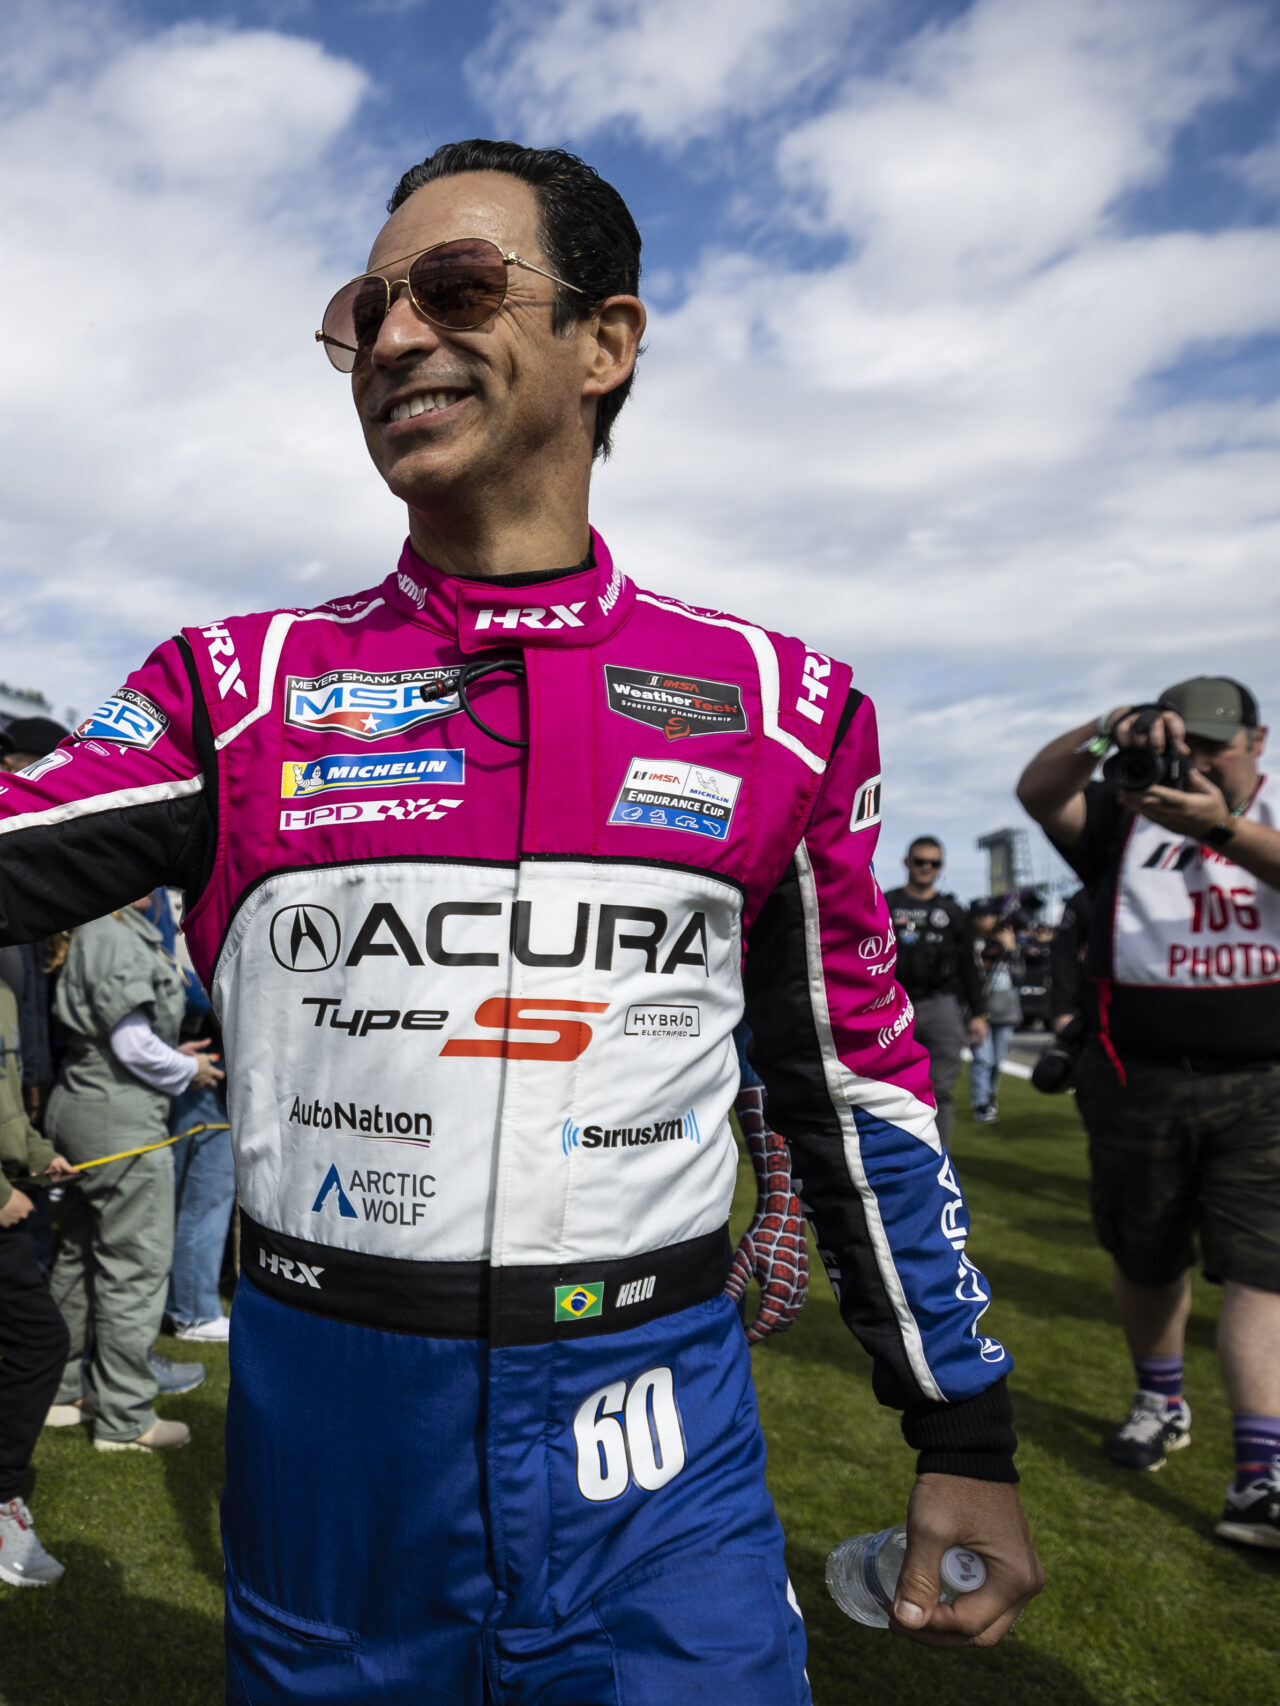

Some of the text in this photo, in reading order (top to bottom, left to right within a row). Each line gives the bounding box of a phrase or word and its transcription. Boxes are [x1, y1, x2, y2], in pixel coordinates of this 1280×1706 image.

[474, 601, 588, 630] HRX
[198, 621, 248, 700] HRX
[291, 668, 461, 690] MEYER SHANK RACING
[663, 679, 699, 693] IMSA
[126, 692, 167, 724] RACING
[295, 682, 455, 716] MSR
[613, 683, 738, 713] WeatherTech
[92, 701, 155, 739] SR
[327, 761, 447, 780] MICHELIN
[648, 773, 681, 785] IMSA
[690, 788, 729, 803] MICHELIN
[285, 805, 363, 827] HPD
[344, 902, 710, 978] ACURA
[438, 996, 611, 1061] S
[634, 1011, 693, 1027] HYBRID
[289, 1095, 432, 1136] AutoNation
[349, 1170, 437, 1198] ARCTIC
[361, 1197, 427, 1226] WOLF
[259, 1247, 326, 1289] HRX
[615, 1275, 657, 1307] HELIO
[573, 1366, 687, 1502] 60
